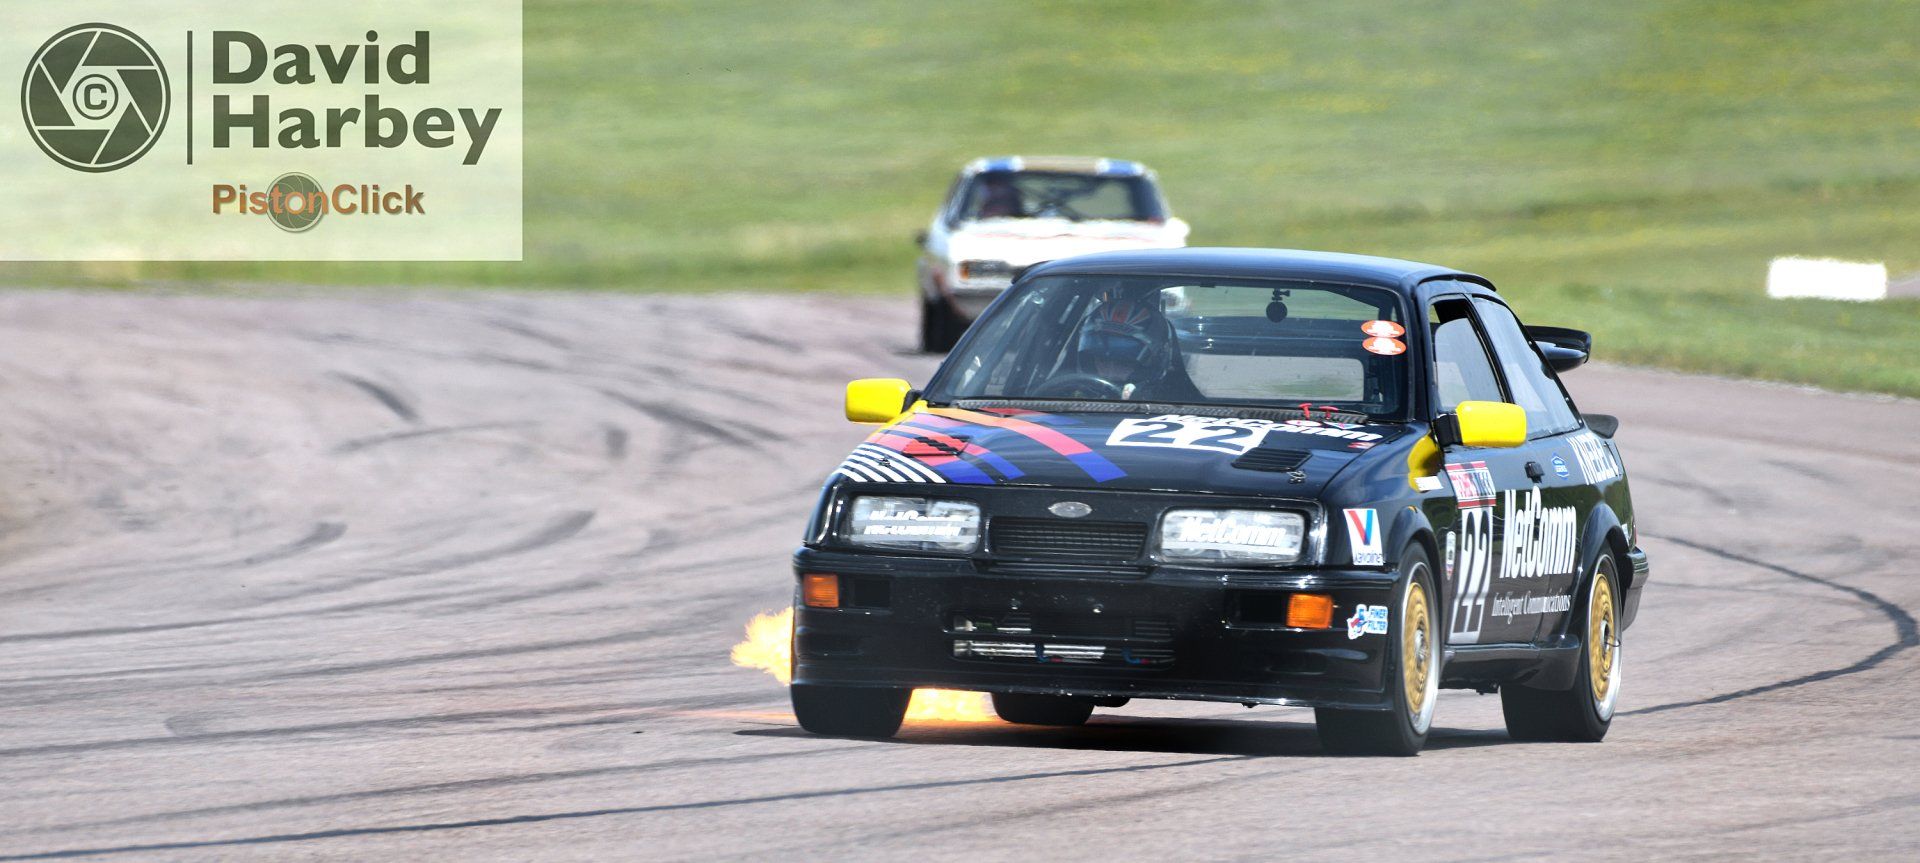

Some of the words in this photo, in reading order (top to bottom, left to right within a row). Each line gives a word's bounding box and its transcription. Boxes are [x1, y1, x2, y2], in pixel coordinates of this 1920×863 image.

[1119, 420, 1253, 452] 22
[1179, 517, 1288, 547] NetComm
[1500, 485, 1577, 579] NetComm
[1453, 510, 1490, 634] 22
[1491, 591, 1524, 625] Intelligent
